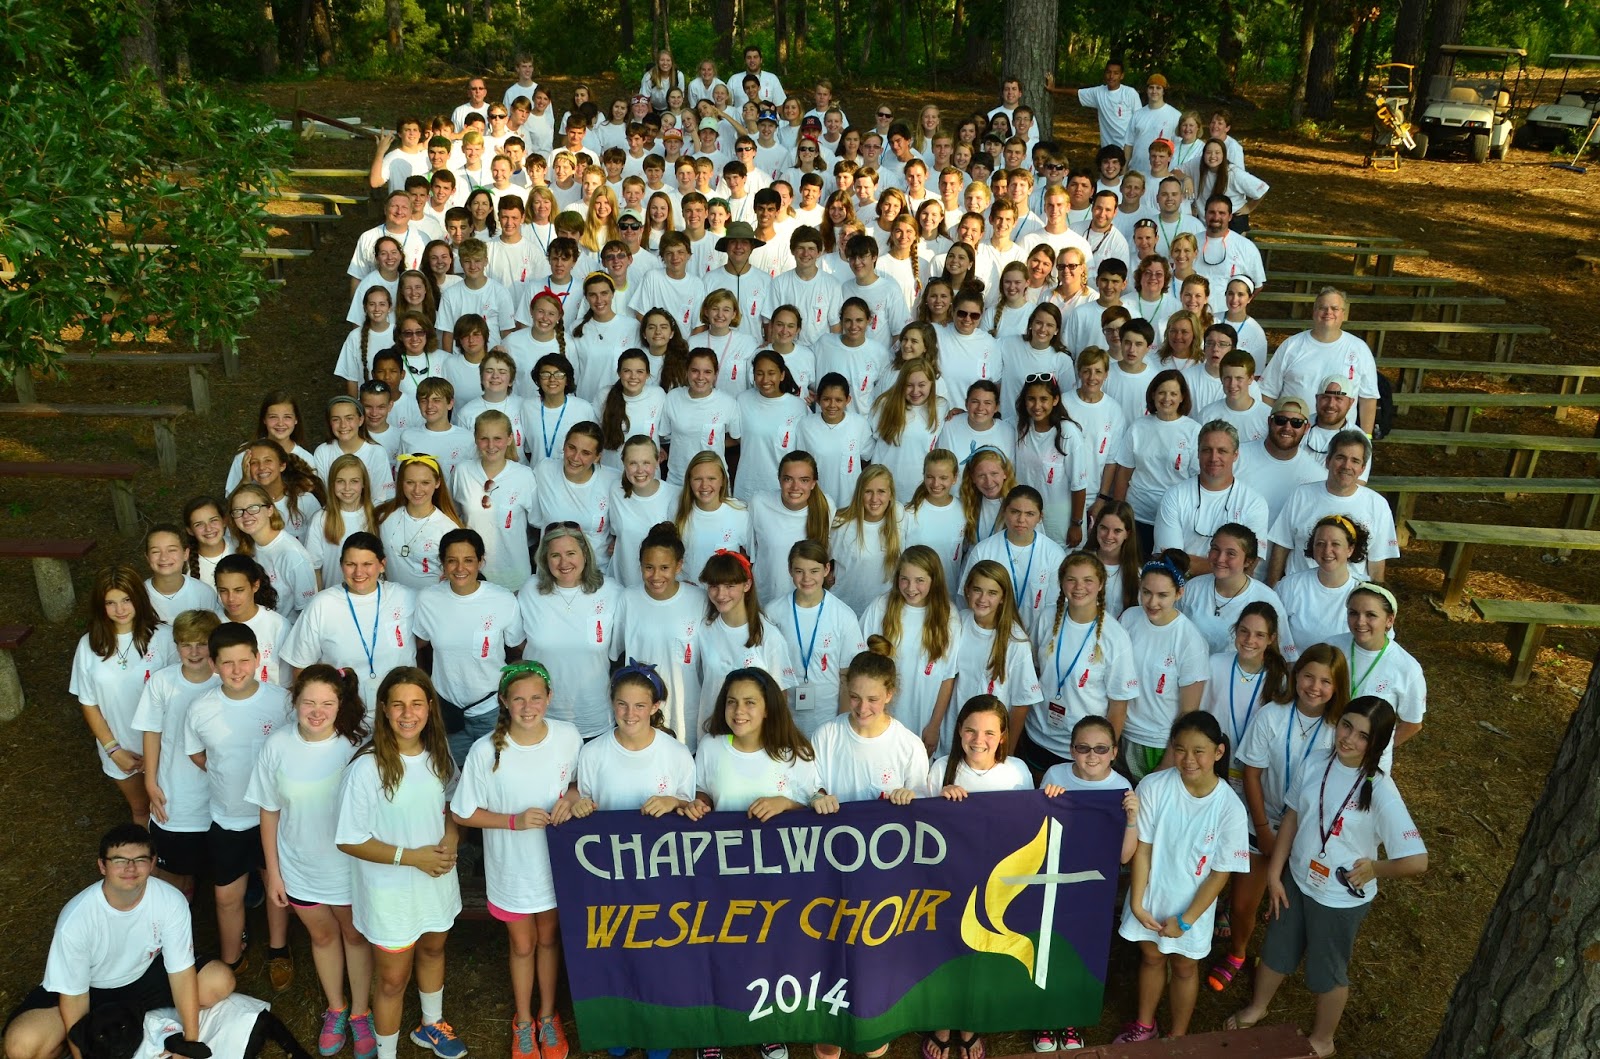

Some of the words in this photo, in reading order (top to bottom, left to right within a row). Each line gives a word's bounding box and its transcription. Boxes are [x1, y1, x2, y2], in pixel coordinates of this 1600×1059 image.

[574, 820, 947, 880] CHAPELWOOD
[586, 899, 790, 949] WESLEY
[800, 888, 952, 947] CHOIR
[746, 971, 851, 1022] 2014
